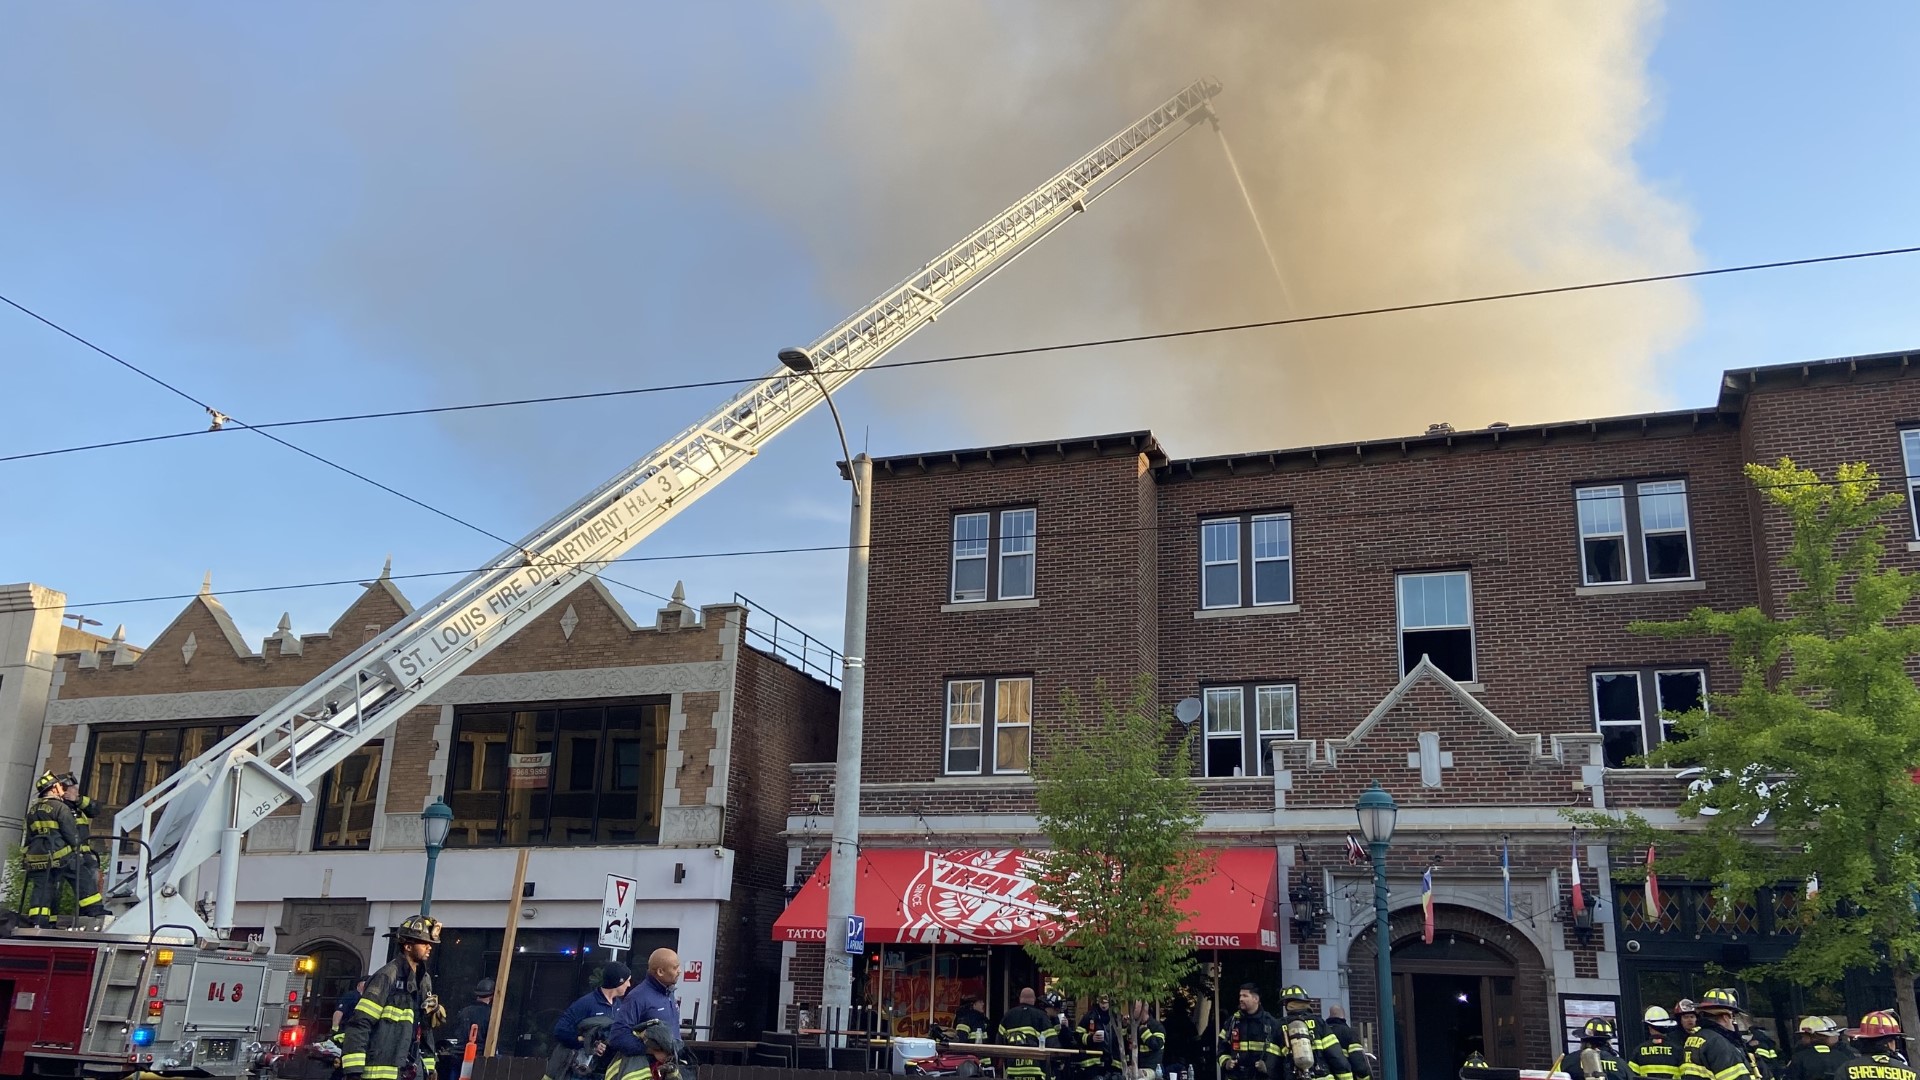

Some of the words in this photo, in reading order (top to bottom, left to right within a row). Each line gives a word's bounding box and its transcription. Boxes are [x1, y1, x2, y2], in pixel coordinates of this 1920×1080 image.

[399, 648, 434, 677] ST.
[430, 606, 487, 650] LOUIS
[486, 577, 528, 614] FIRE
[525, 507, 626, 586] DEPARTMENT
[624, 488, 657, 517] H&L
[657, 475, 672, 492] 3
[251, 801, 271, 818] 125
[935, 864, 1022, 897] IRON
[912, 883, 926, 907] SINCE
[605, 907, 618, 918] HERE
[248, 933, 262, 943] 631
[786, 928, 827, 939] TATTO
[1176, 935, 1240, 947] IERCING
[231, 983, 243, 1002] 3
[1640, 1046, 1673, 1056] OLIVETTE
[1848, 1065, 1917, 1080] SHREWSBURY
